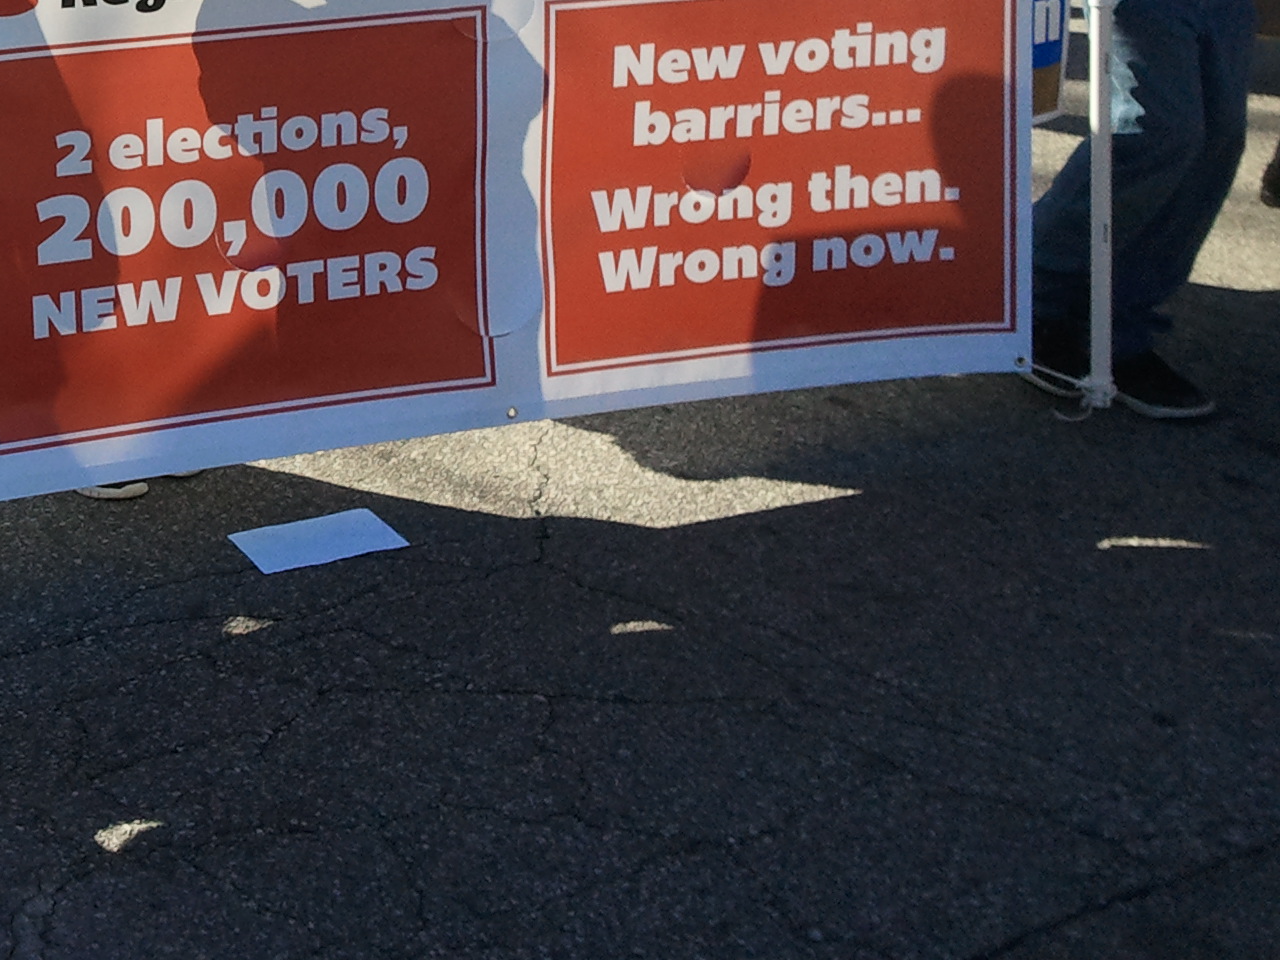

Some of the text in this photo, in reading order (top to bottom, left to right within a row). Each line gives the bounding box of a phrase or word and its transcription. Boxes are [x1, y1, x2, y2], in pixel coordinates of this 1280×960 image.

[612, 21, 947, 89] New voting
[55, 107, 408, 178] 2 elections,
[633, 89, 922, 147] barriers...
[36, 157, 430, 267] 200,000
[591, 165, 960, 234] Wrong then.
[32, 246, 439, 340] NEW VOTERS
[598, 228, 955, 295] Wrong now.
